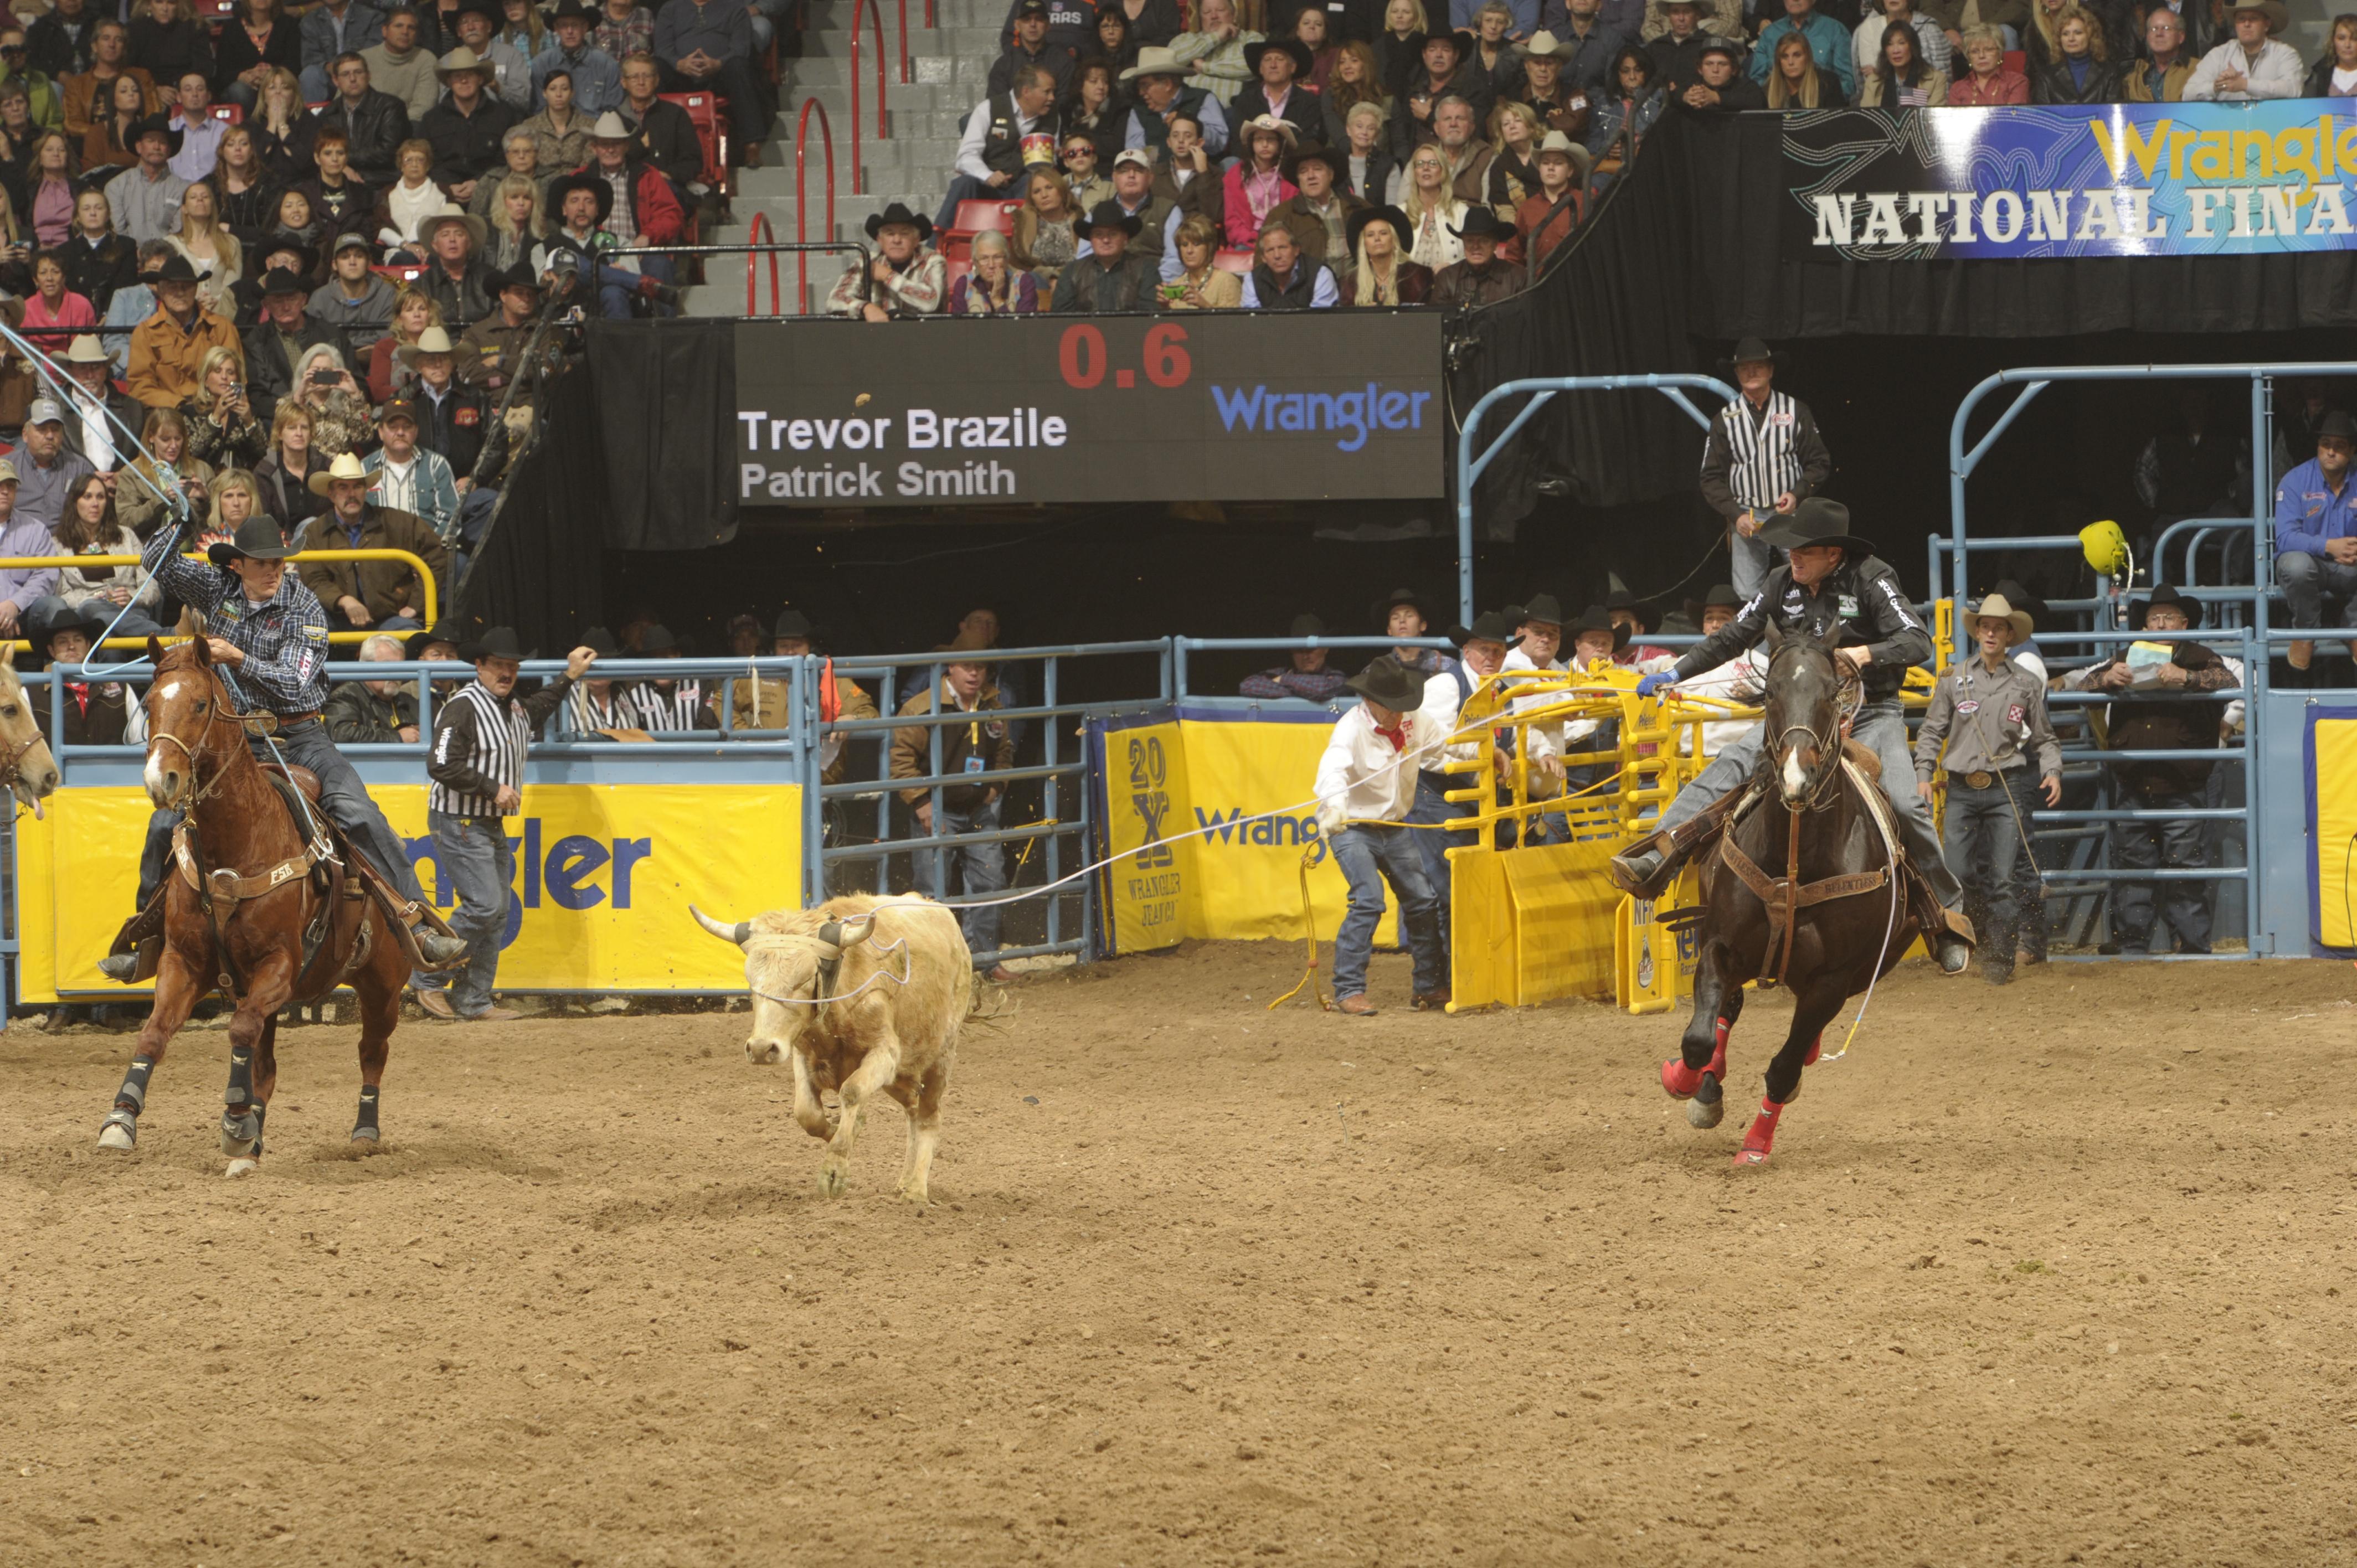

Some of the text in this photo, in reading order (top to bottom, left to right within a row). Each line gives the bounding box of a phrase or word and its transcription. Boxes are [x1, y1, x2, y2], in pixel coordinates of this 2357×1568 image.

[1048, 11, 1082, 24] ARS
[2090, 114, 2357, 207] Wrangl
[1813, 182, 2355, 246] NATIONAL FINA
[1059, 323, 1192, 389] 0.6
[738, 408, 1067, 450] Trevor Brazile
[1211, 382, 1431, 452] Wrangler
[740, 460, 1016, 497] Patrick Smith
[1839, 595, 1859, 612] 3S
[435, 726, 452, 765] Wrangler
[1128, 736, 1166, 790] 20
[1132, 791, 1173, 870] X
[1193, 807, 1327, 864] Wrang
[400, 817, 651, 952] nler
[1128, 872, 1181, 901] WRANGLER
